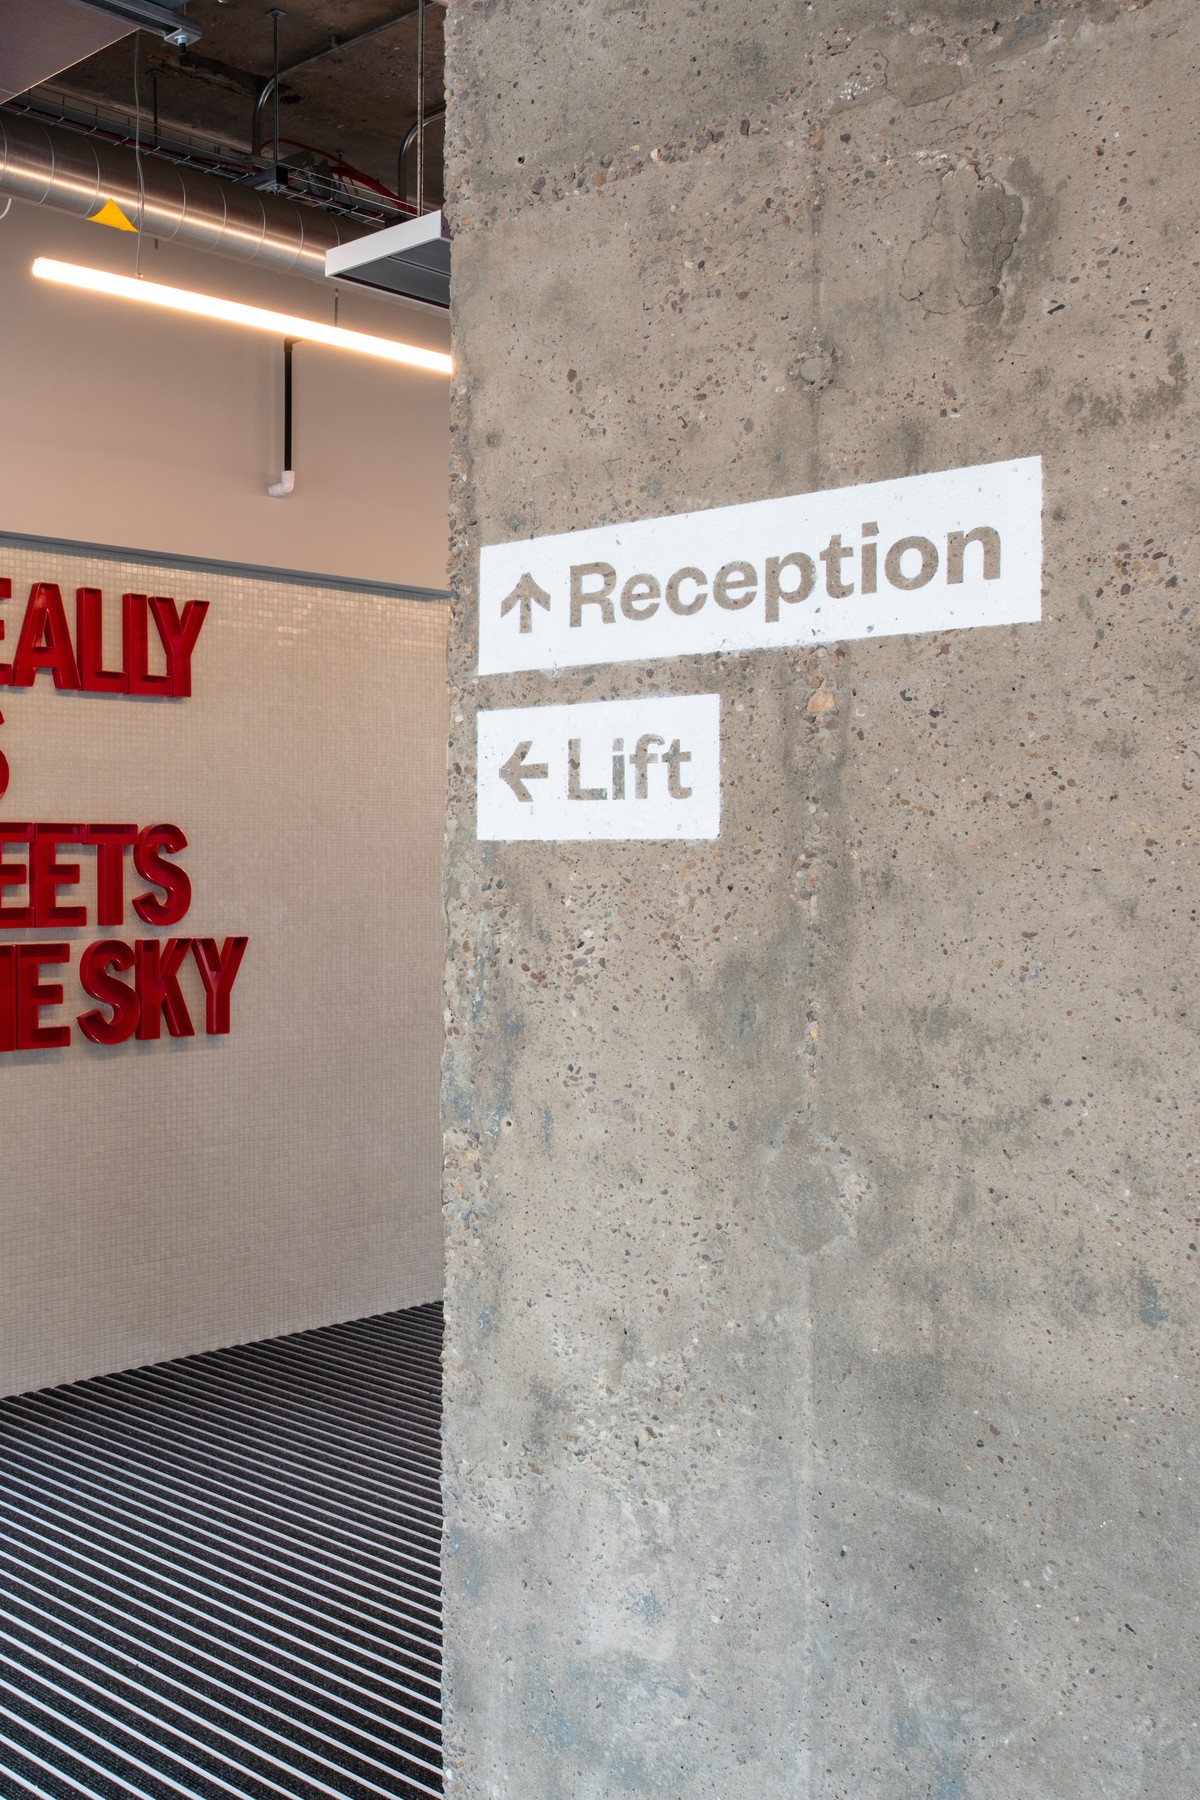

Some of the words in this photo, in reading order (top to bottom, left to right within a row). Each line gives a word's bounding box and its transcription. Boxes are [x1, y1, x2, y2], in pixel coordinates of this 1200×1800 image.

[569, 521, 1001, 628] Reception
[567, 733, 692, 801] Lift
[77, 937, 248, 1045] SKY
